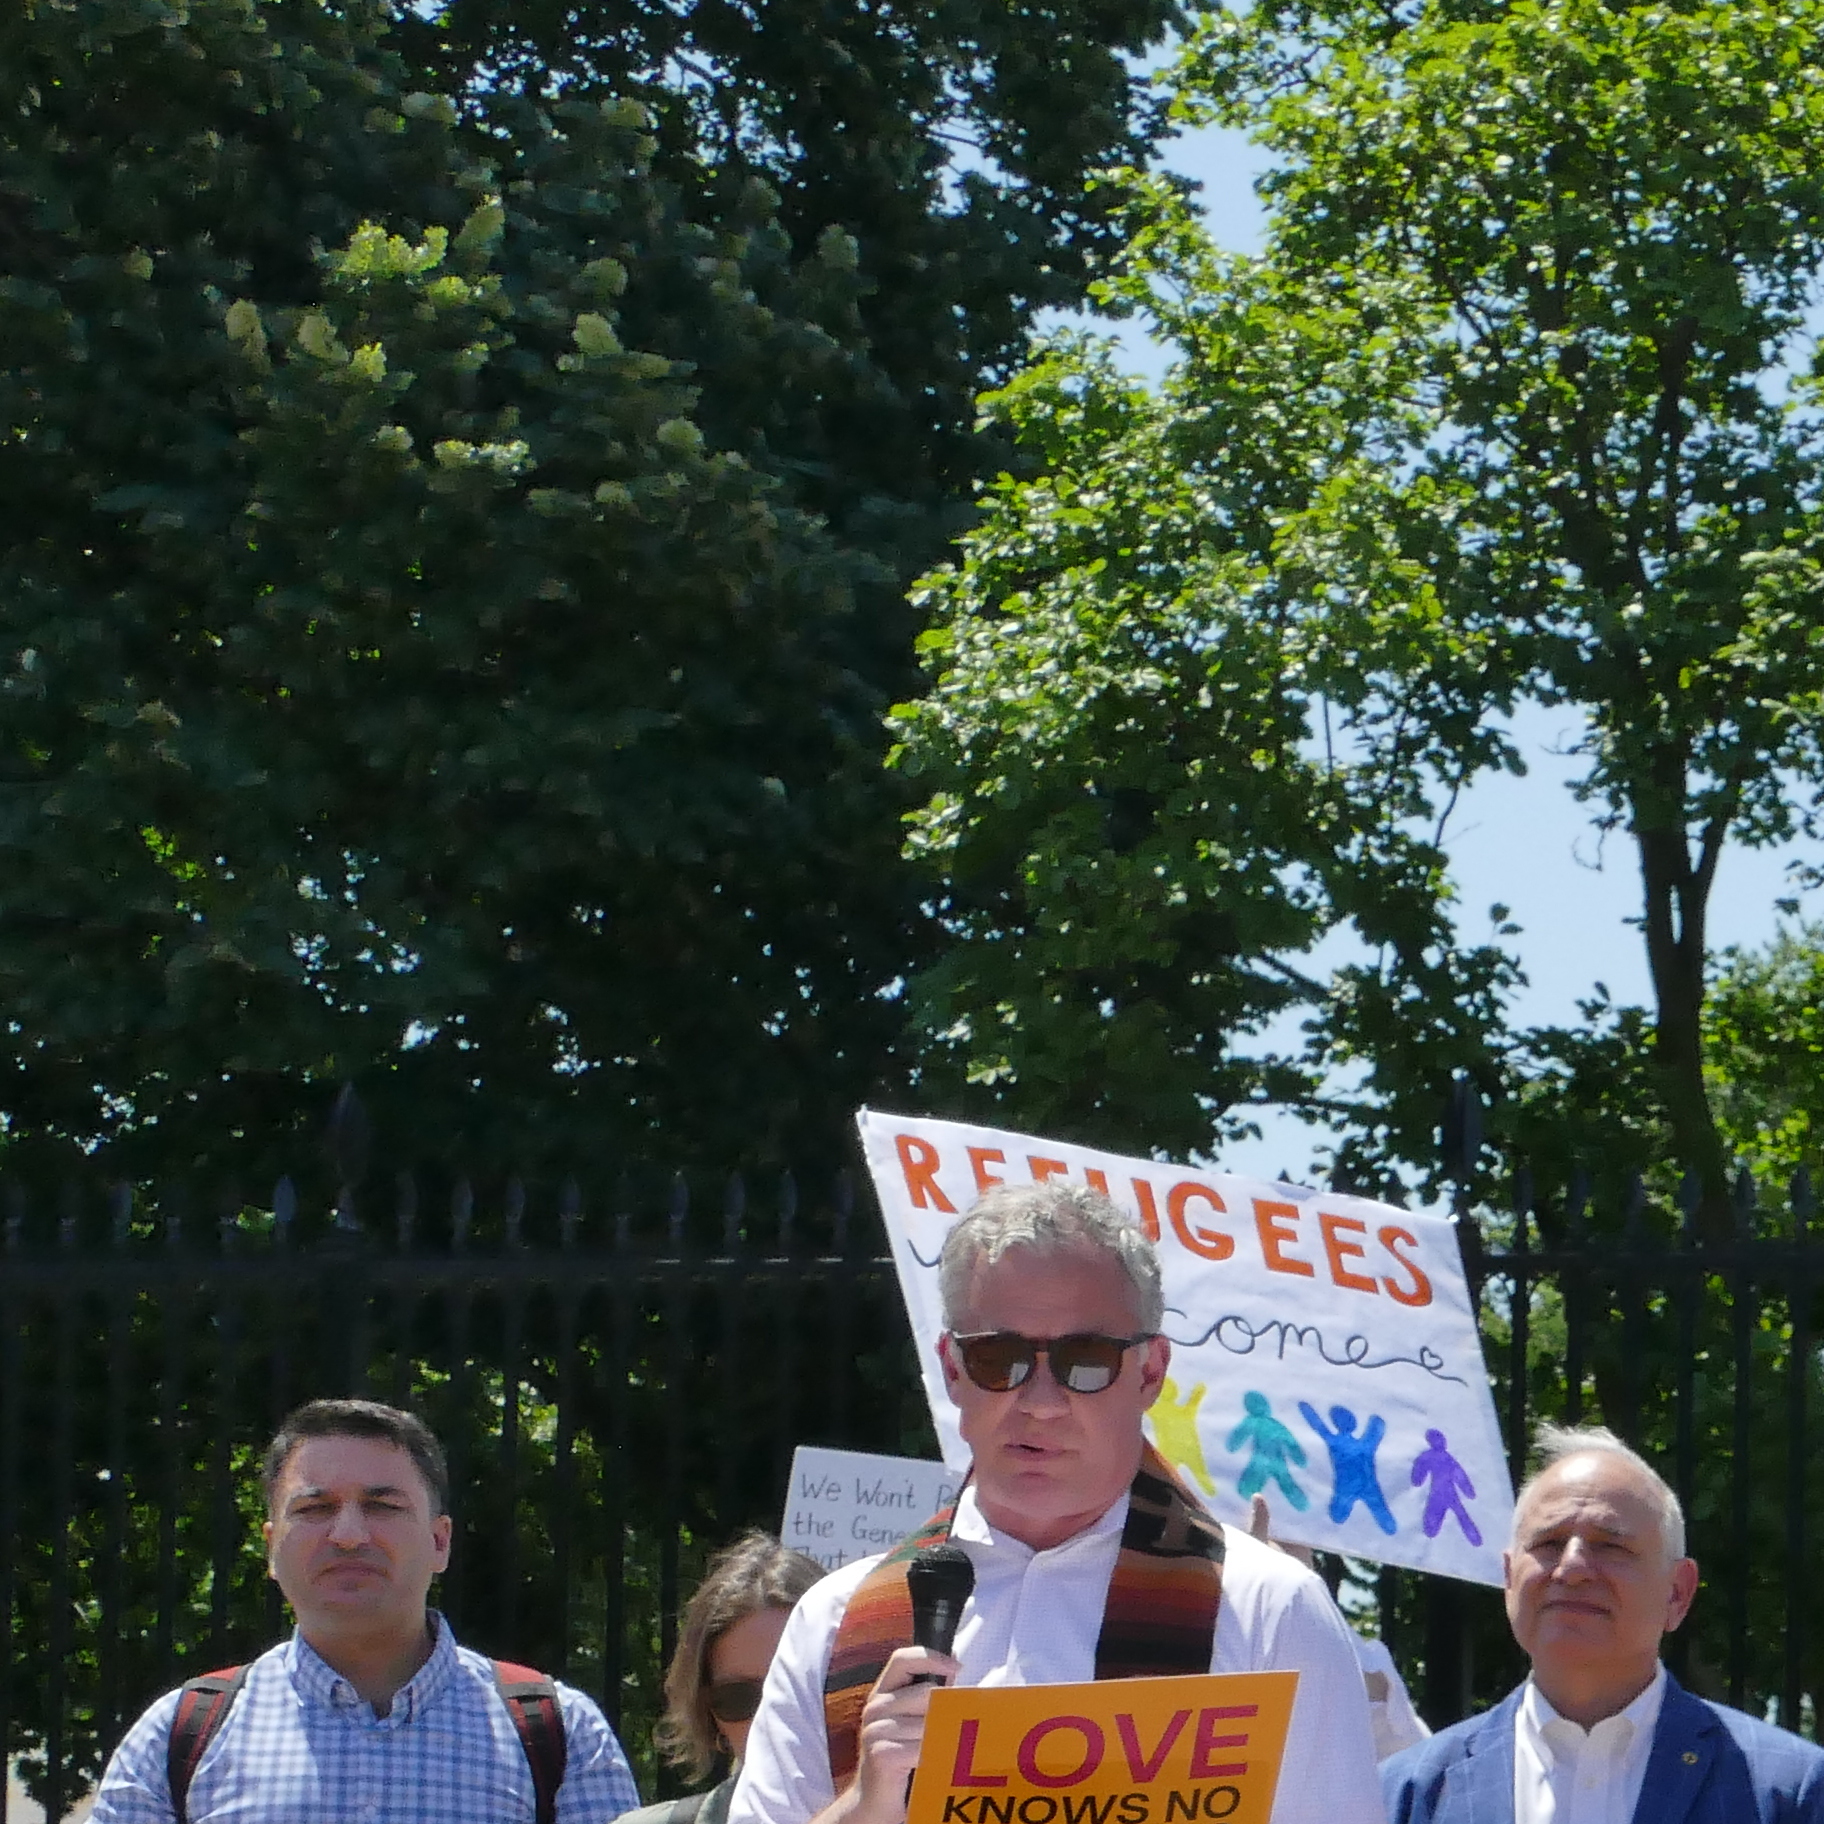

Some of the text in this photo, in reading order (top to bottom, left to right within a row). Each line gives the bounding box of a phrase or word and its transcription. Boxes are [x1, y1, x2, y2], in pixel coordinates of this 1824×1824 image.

[801, 1473, 842, 1502] We
[793, 1512, 835, 1538] the
[950, 1704, 1259, 1789] LOVE
[1165, 1785, 1242, 1823] NO
